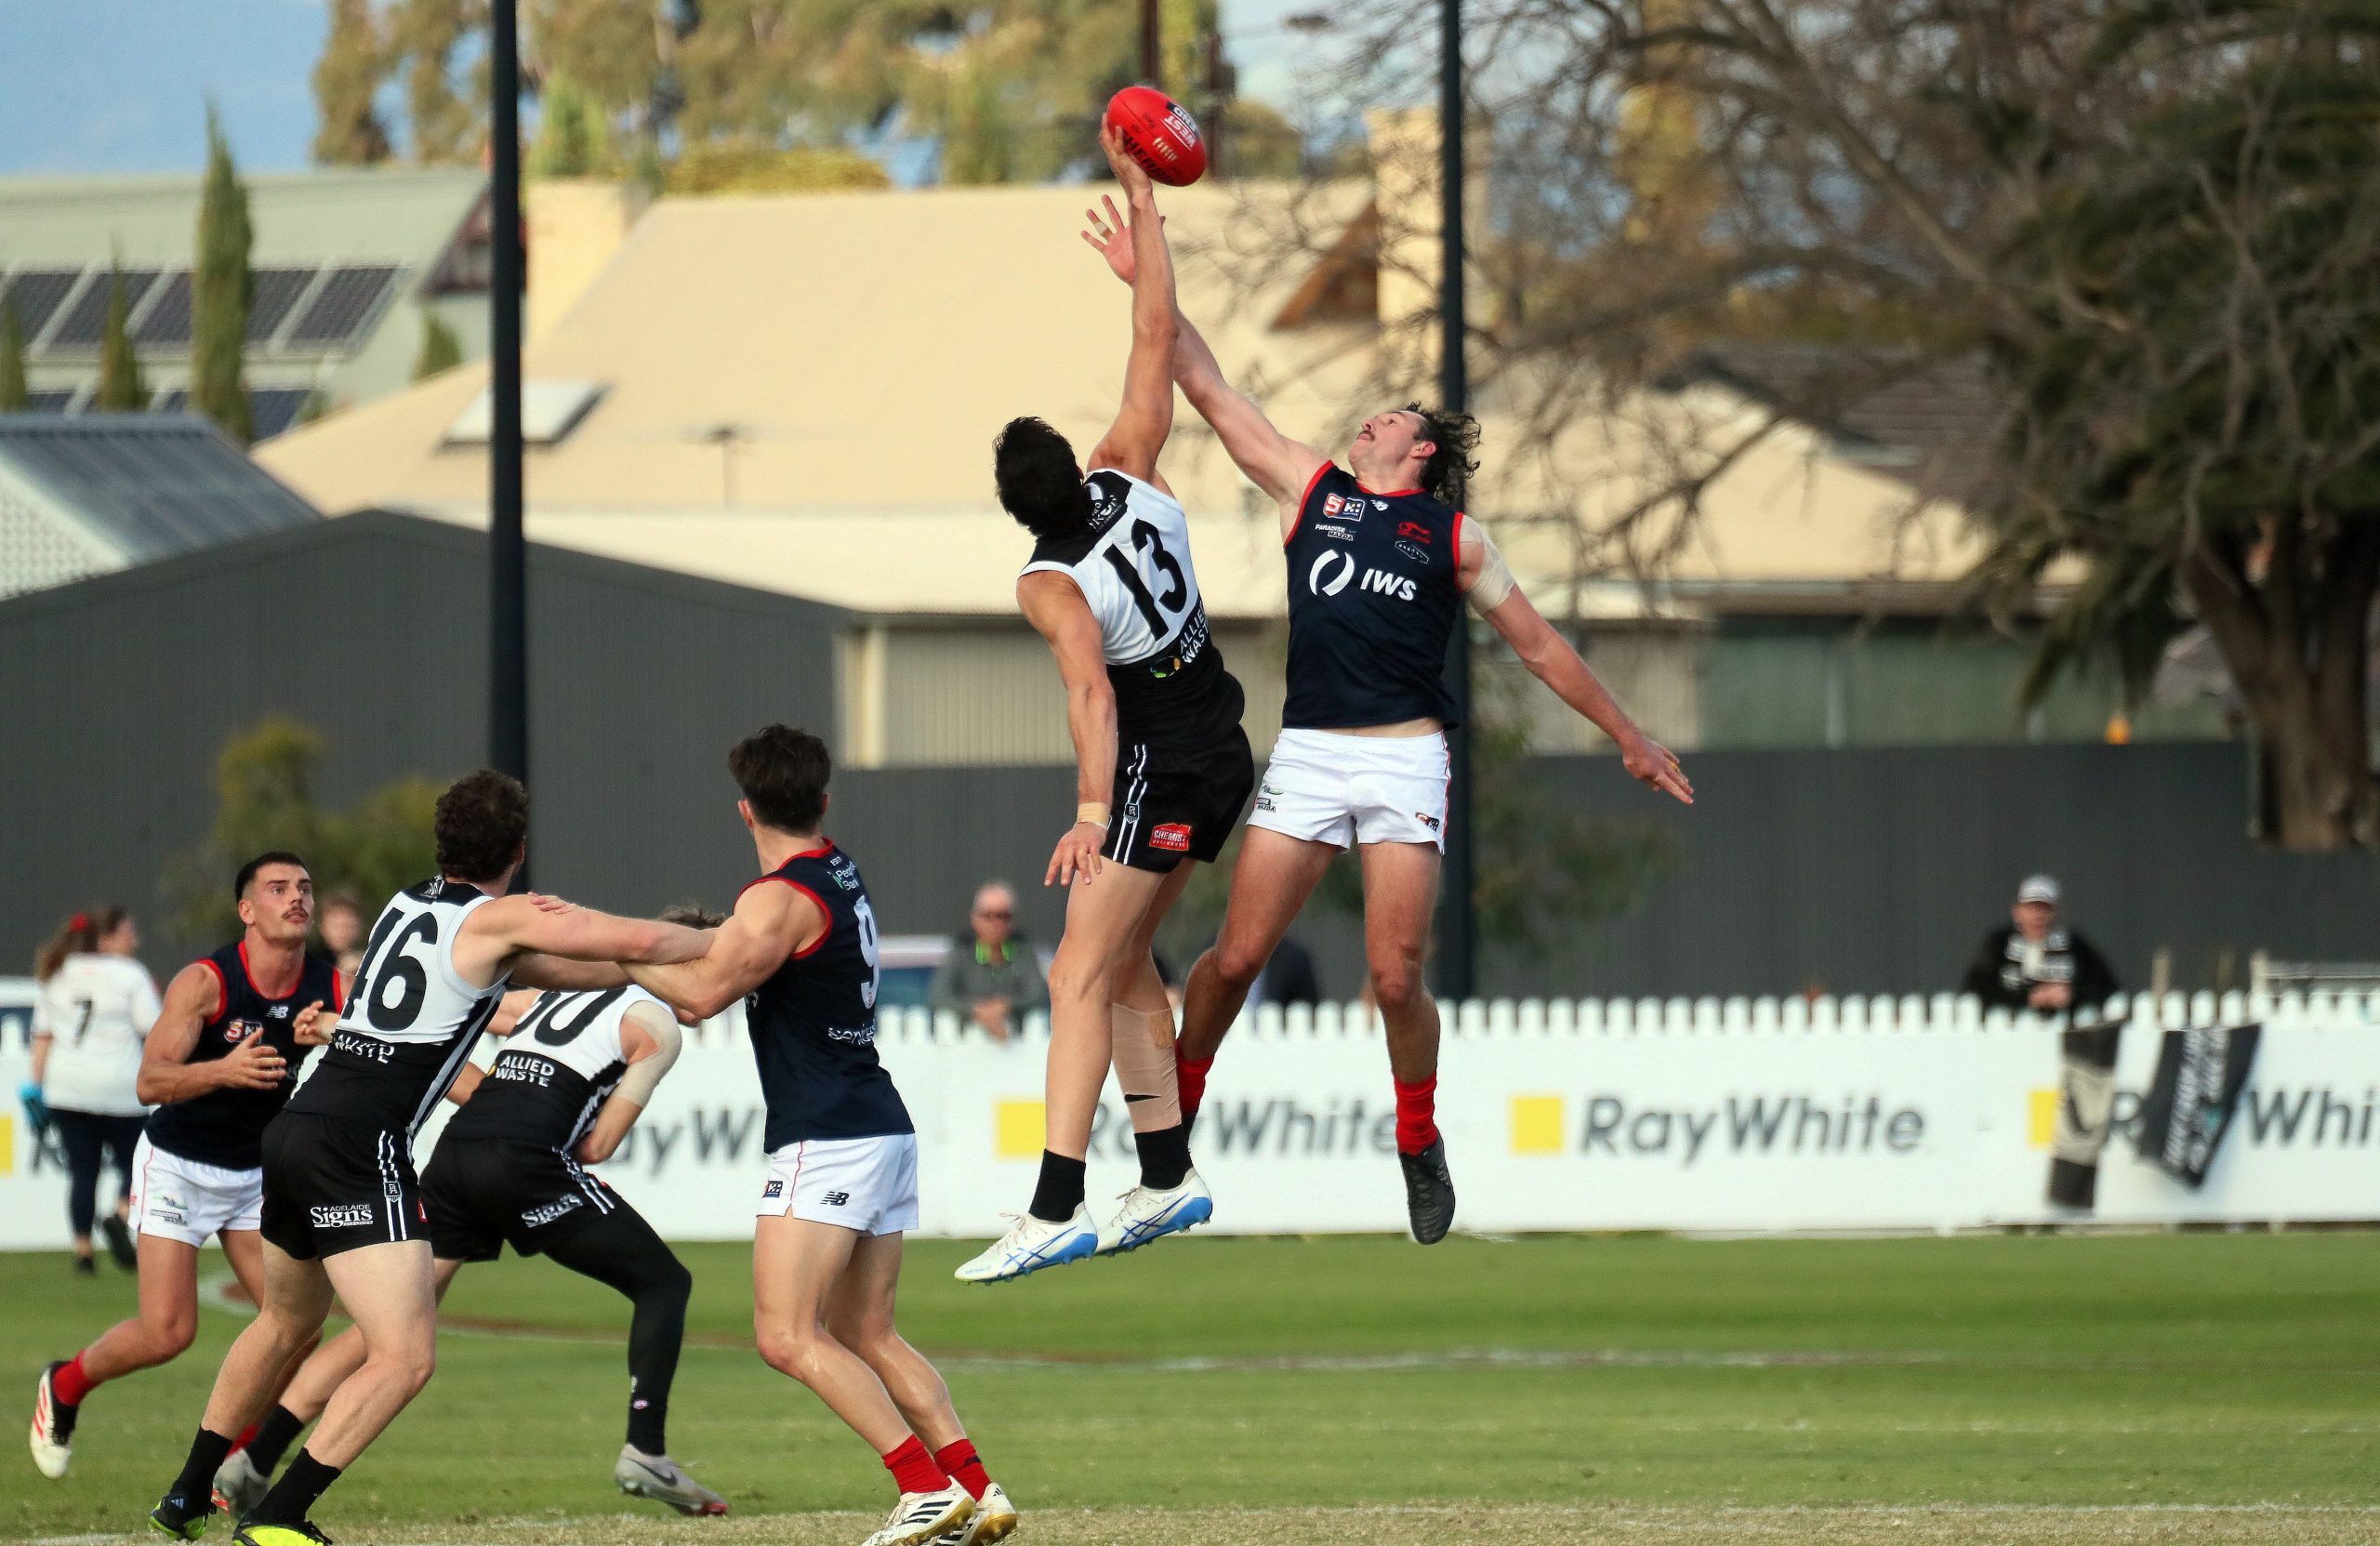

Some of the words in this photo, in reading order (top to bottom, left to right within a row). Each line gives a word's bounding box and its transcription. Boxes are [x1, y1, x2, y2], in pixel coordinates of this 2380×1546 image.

[1163, 114, 1196, 148] WEST
[1102, 518, 1187, 642] 13
[1360, 568, 1417, 602] IWS
[1182, 621, 1209, 664] WAST
[853, 894, 879, 1009] 9
[73, 996, 94, 1050] 7
[495, 1068, 551, 1089] WASTE
[500, 1055, 555, 1078] ALLIED
[310, 1207, 373, 1228] Signs
[330, 1204, 371, 1212] ADELAIDE
